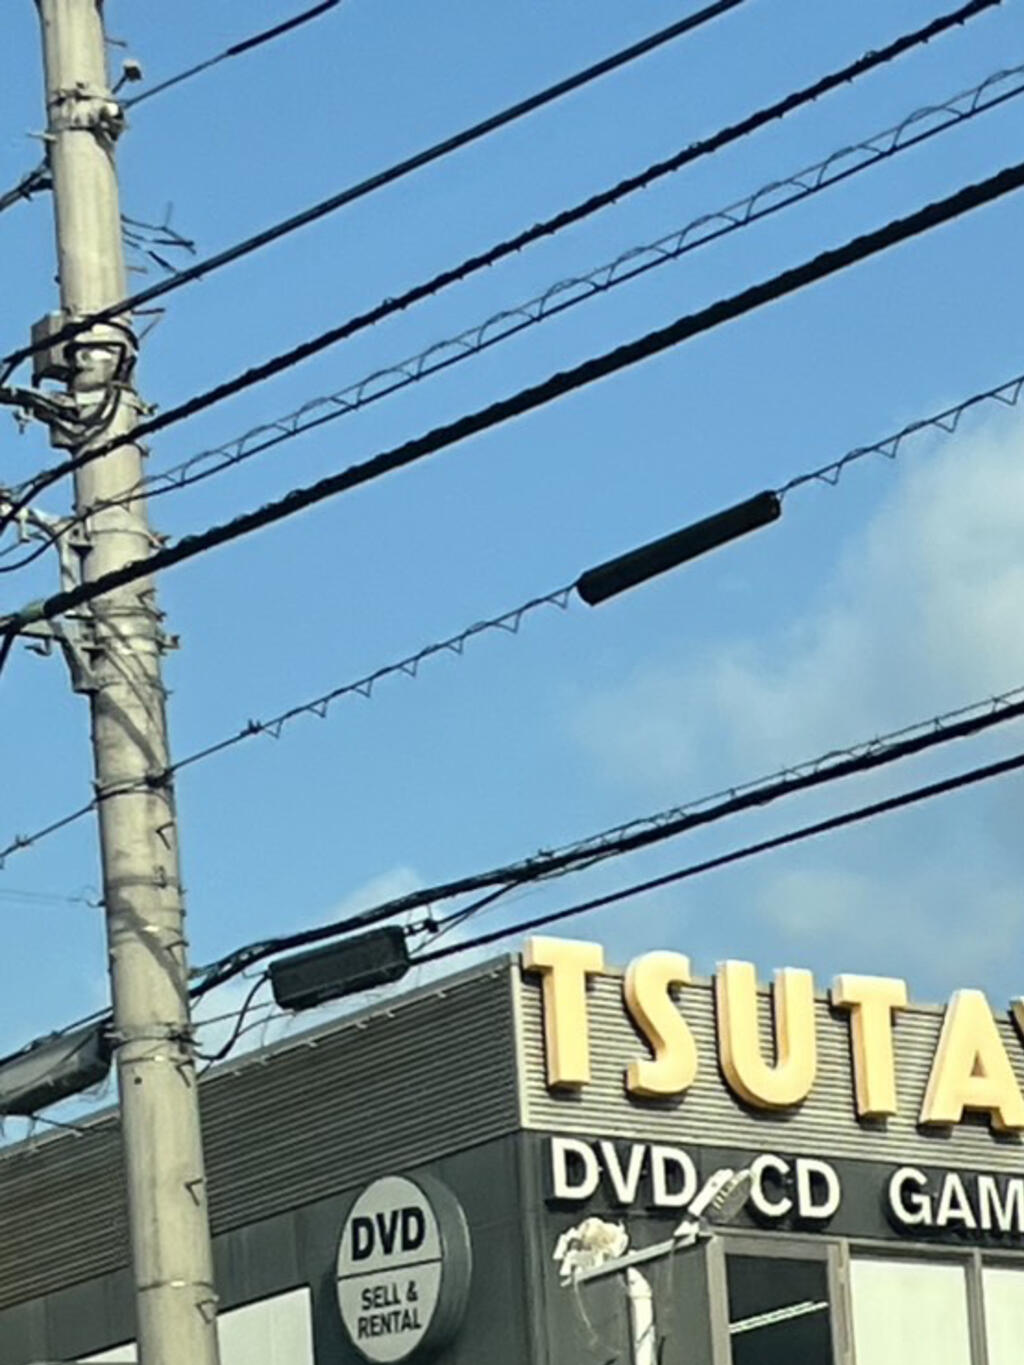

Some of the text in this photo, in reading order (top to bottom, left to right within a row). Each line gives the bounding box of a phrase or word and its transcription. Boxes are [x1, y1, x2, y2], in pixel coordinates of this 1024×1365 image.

[551, 1136, 697, 1207] DVD
[749, 1152, 841, 1218] CD
[351, 1206, 426, 1262] DVD
[361, 1280, 419, 1311] SELL &
[357, 1308, 422, 1340] RENTAL
